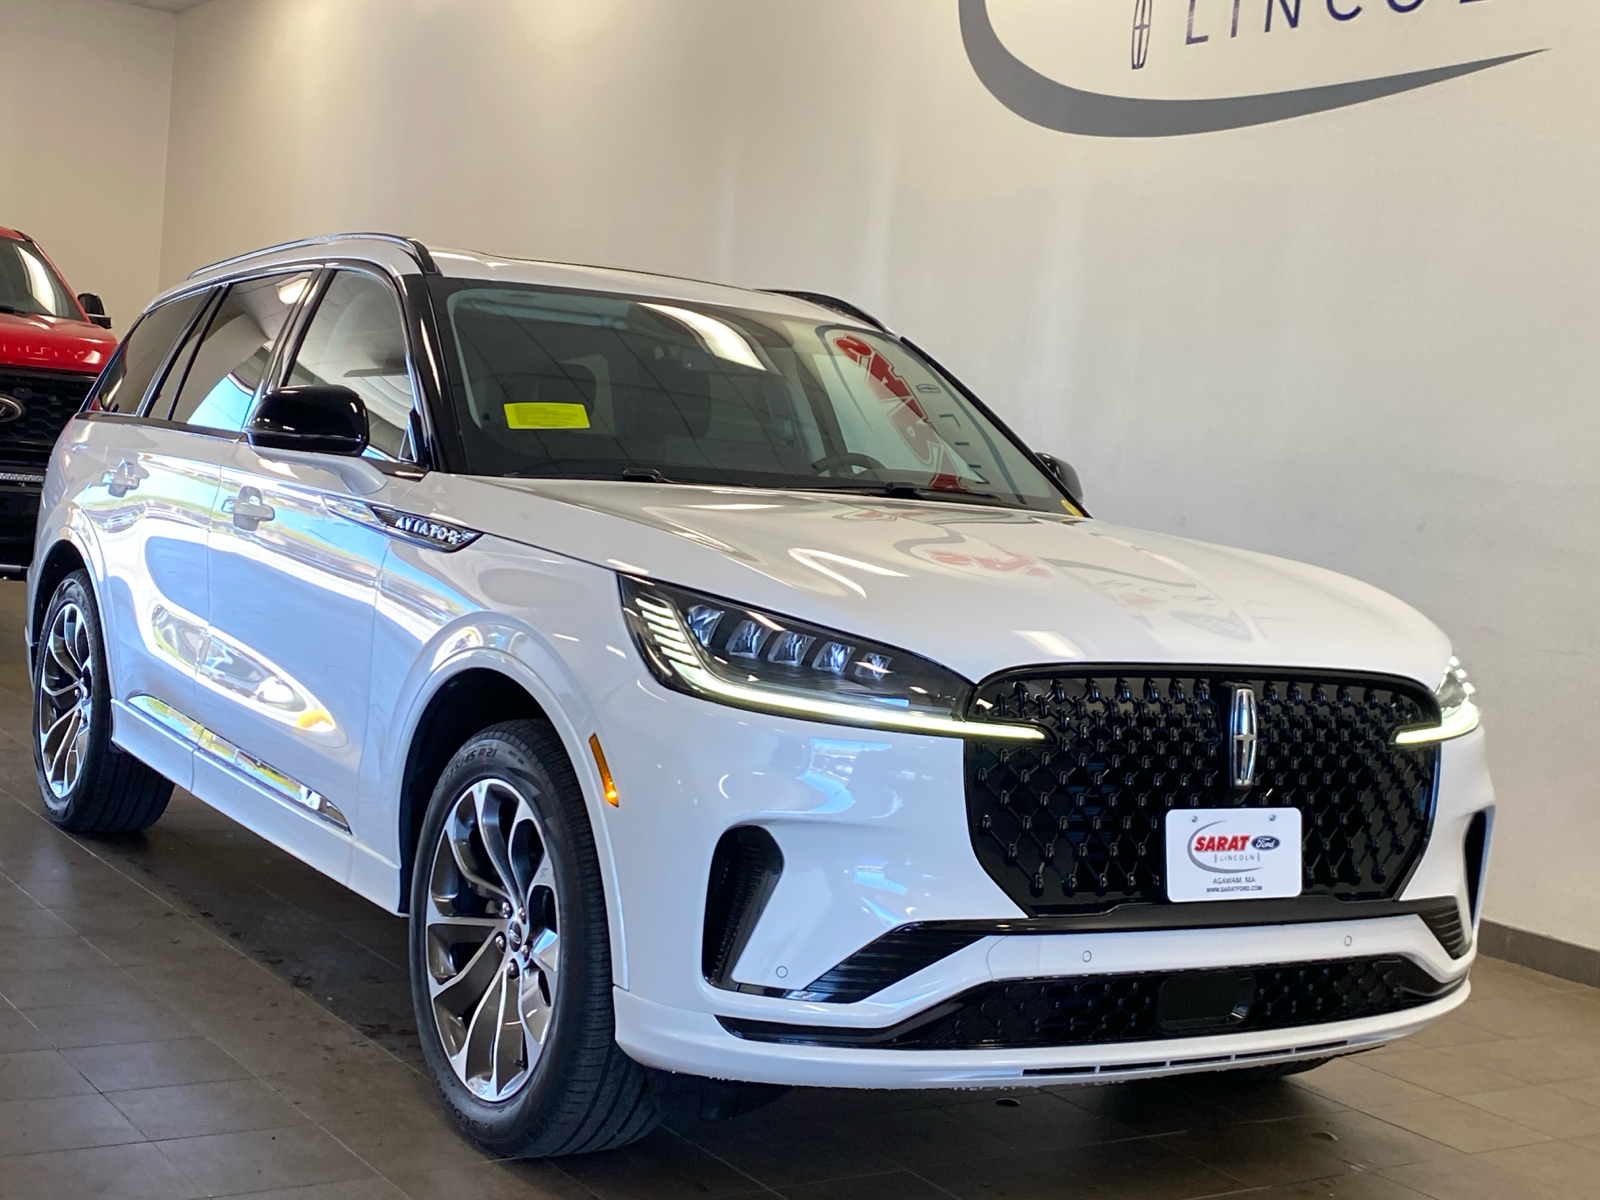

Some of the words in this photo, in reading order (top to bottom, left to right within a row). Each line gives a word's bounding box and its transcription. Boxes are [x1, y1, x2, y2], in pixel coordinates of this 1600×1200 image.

[395, 517, 458, 544] AVIATOR
[1194, 835, 1250, 852] SARAT
[1206, 885, 1263, 893] WWW.SARATFORD.COM
